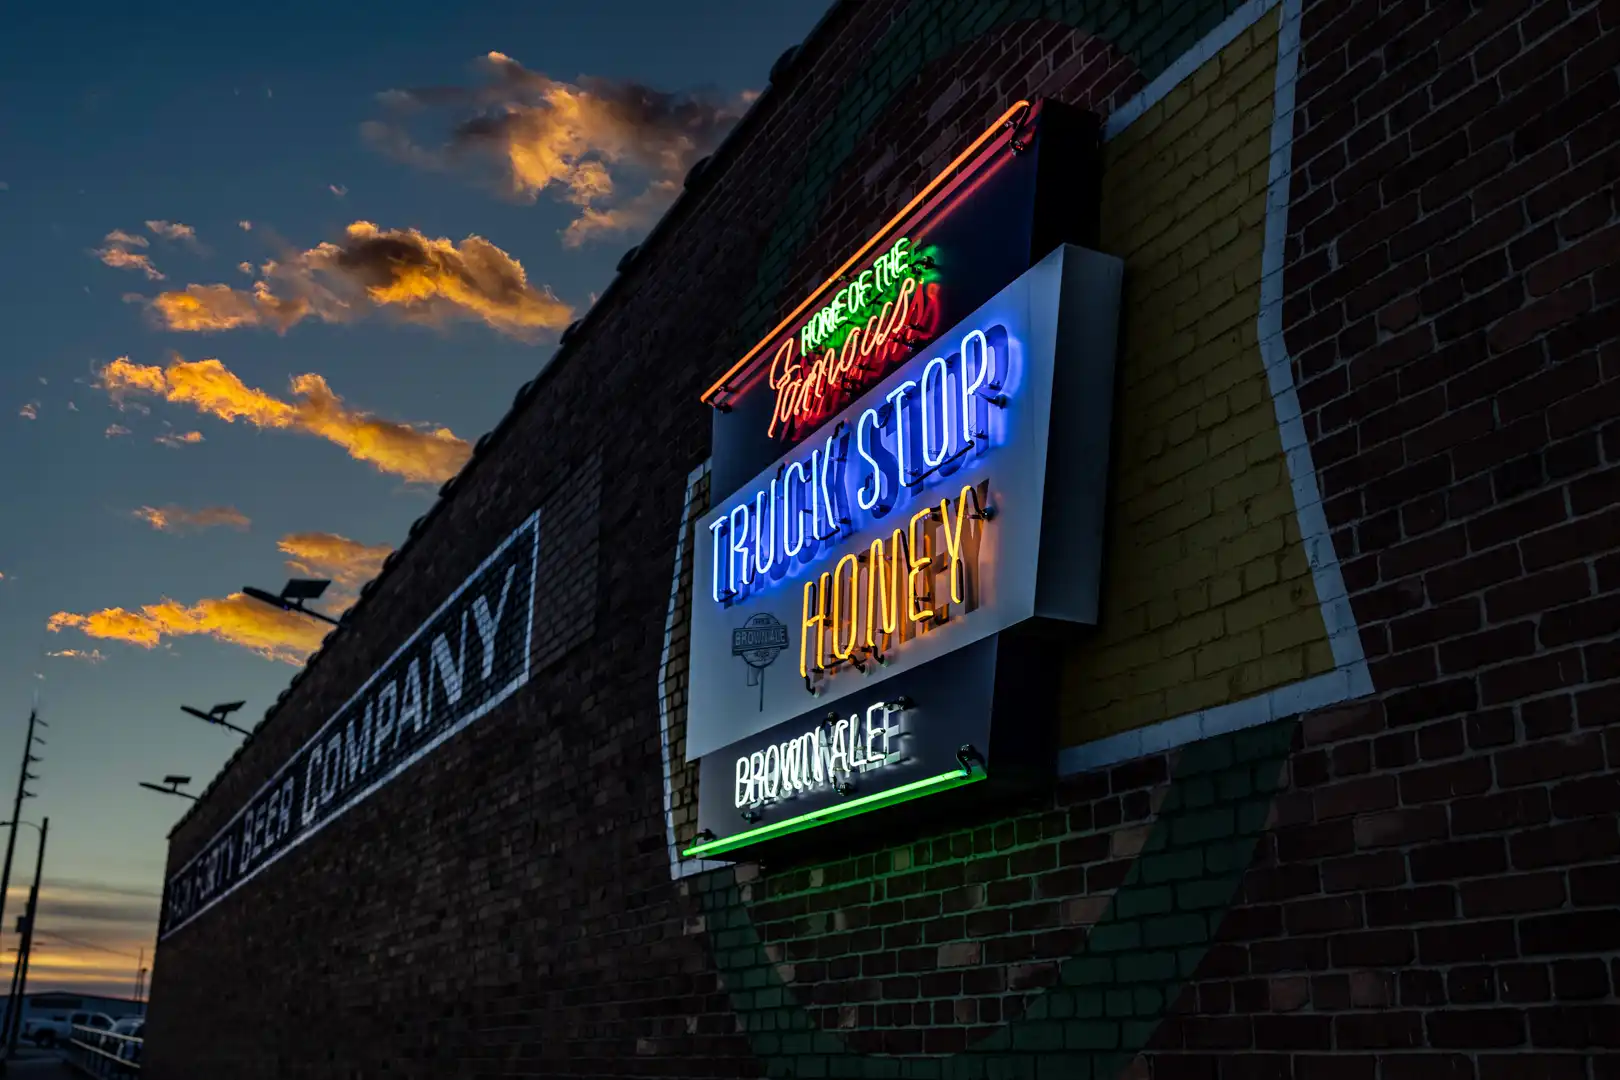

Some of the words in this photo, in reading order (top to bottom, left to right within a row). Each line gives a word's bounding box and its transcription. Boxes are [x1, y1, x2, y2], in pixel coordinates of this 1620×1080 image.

[801, 289, 848, 356] HOME
[848, 270, 873, 313] OF
[873, 237, 911, 292] THE
[709, 436, 840, 604] TRUCK
[857, 329, 988, 511] STOP
[735, 632, 767, 646] BROWN
[770, 628, 785, 643] ALE
[799, 485, 976, 680] HONEY
[239, 777, 295, 874] BEER
[301, 563, 516, 826] COMPANY
[735, 727, 823, 808] BROWN
